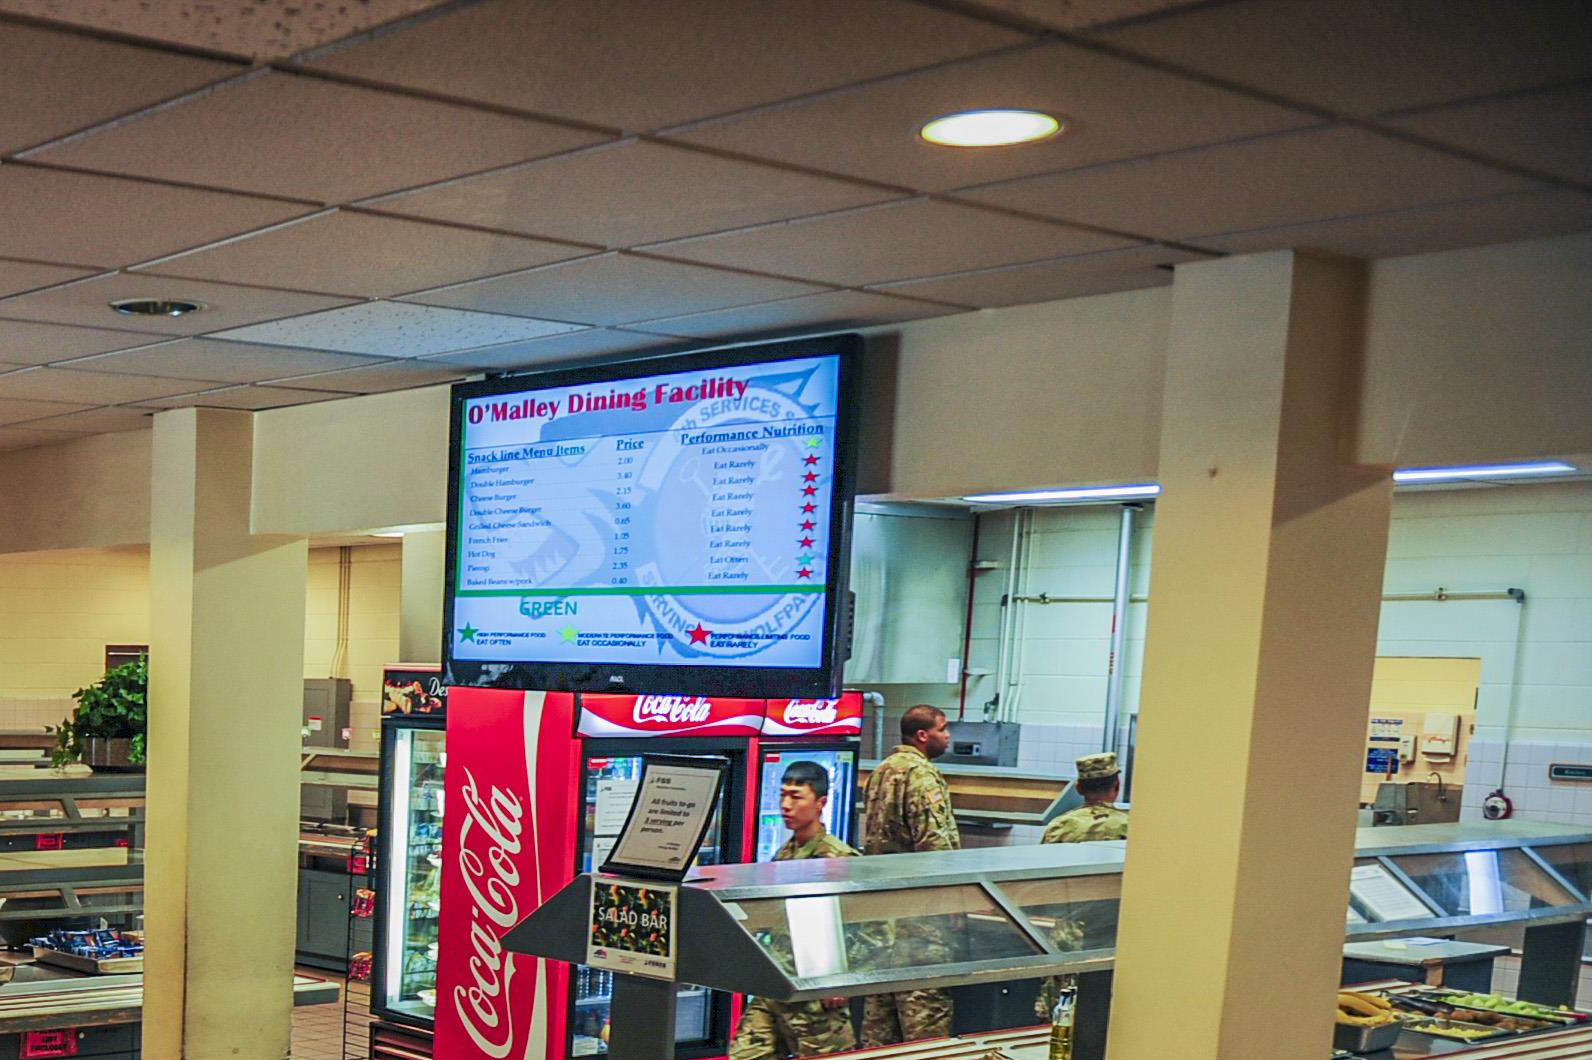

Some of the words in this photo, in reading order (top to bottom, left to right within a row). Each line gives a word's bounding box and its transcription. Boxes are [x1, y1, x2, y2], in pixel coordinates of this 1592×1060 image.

[468, 398, 561, 425] O'Malley
[568, 388, 647, 414] Dining
[654, 376, 750, 405] Facility
[680, 429, 759, 446] Performance
[762, 421, 824, 440] Nutrition
[616, 437, 645, 452] Price
[701, 446, 715, 455] Eat
[716, 442, 769, 454] Occasionally
[467, 449, 500, 464] Snack
[522, 445, 554, 460] Menu
[555, 443, 586, 457] Items
[617, 455, 634, 465] 2.00
[713, 460, 728, 469] Eat
[729, 460, 755, 470] Rarely
[470, 465, 510, 476] Hamburger
[470, 481, 494, 489] Double
[495, 478, 535, 487] Hamburger
[712, 477, 727, 486] Eat
[728, 476, 755, 486] Rarely
[615, 486, 632, 495] 2.15
[494, 493, 518, 503] Burger
[712, 493, 726, 501] Eat
[727, 492, 754, 502] Rarely
[615, 502, 631, 510] 3.60
[711, 509, 725, 517] Eat
[726, 508, 753, 518] Rarely
[517, 519, 552, 528] Sandwich
[710, 525, 724, 533] Eat
[725, 524, 752, 534] Rarely
[709, 540, 723, 548] Eat
[724, 540, 751, 549] Rarely
[481, 550, 496, 559] Dog
[611, 561, 628, 570] 2.35
[723, 572, 749, 581] Rarely
[466, 578, 487, 586] Baked
[518, 600, 578, 616] GREEN
[656, 632, 674, 640] FOOD
[576, 639, 590, 647] EAT
[591, 639, 647, 648] OCCASIONALLY
[710, 640, 726, 648] EAT
[726, 641, 759, 649] RARELY
[429, 676, 449, 697] Des
[453, 766, 524, 1059] Coca-Cola
[598, 906, 638, 925] SALAD
[641, 913, 668, 930] BAR
